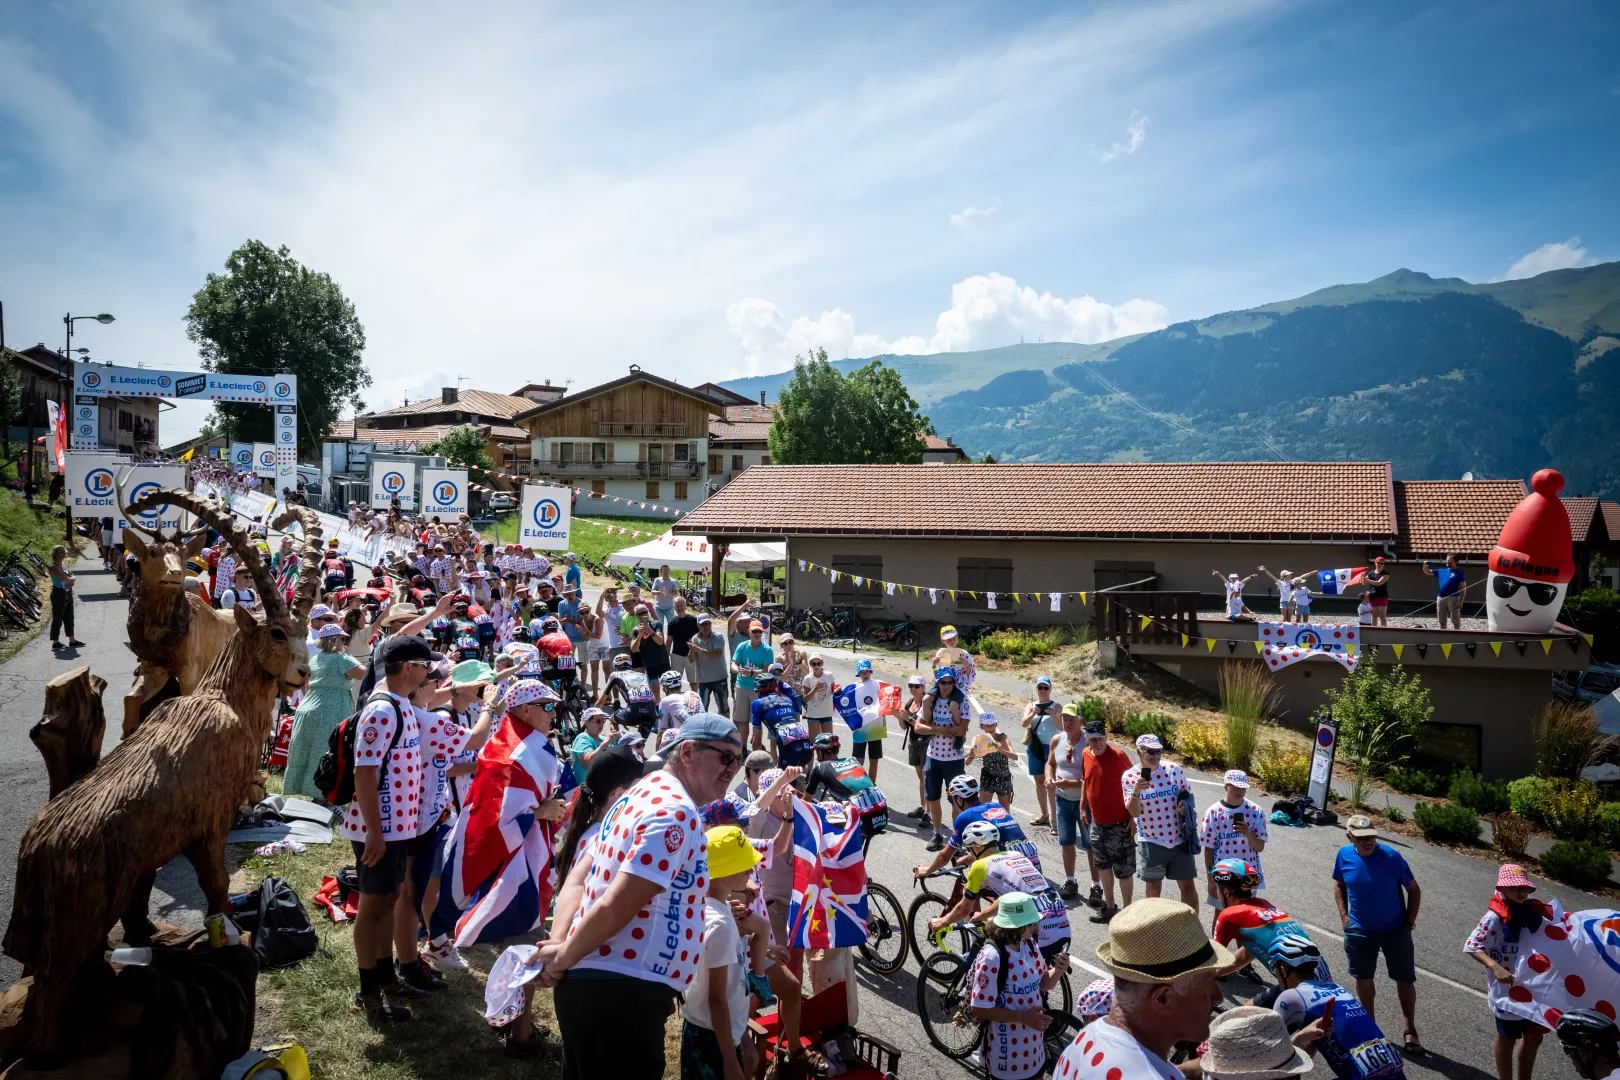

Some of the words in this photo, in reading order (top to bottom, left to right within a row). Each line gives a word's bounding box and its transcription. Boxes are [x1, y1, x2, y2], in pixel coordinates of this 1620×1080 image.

[110, 375, 157, 385] E.Leclerc
[177, 377, 204, 388] SOMMET
[210, 381, 252, 390] E.Leclerc
[374, 493, 411, 501] E.Leerc
[425, 505, 465, 513] E.Leclerc
[524, 528, 567, 539] E.Leclerc
[1498, 553, 1510, 568] la
[1511, 557, 1559, 576] Plagne
[830, 759, 856, 769] BORA
[871, 814, 887, 825] BORA
[1356, 1044, 1389, 1073] 166
